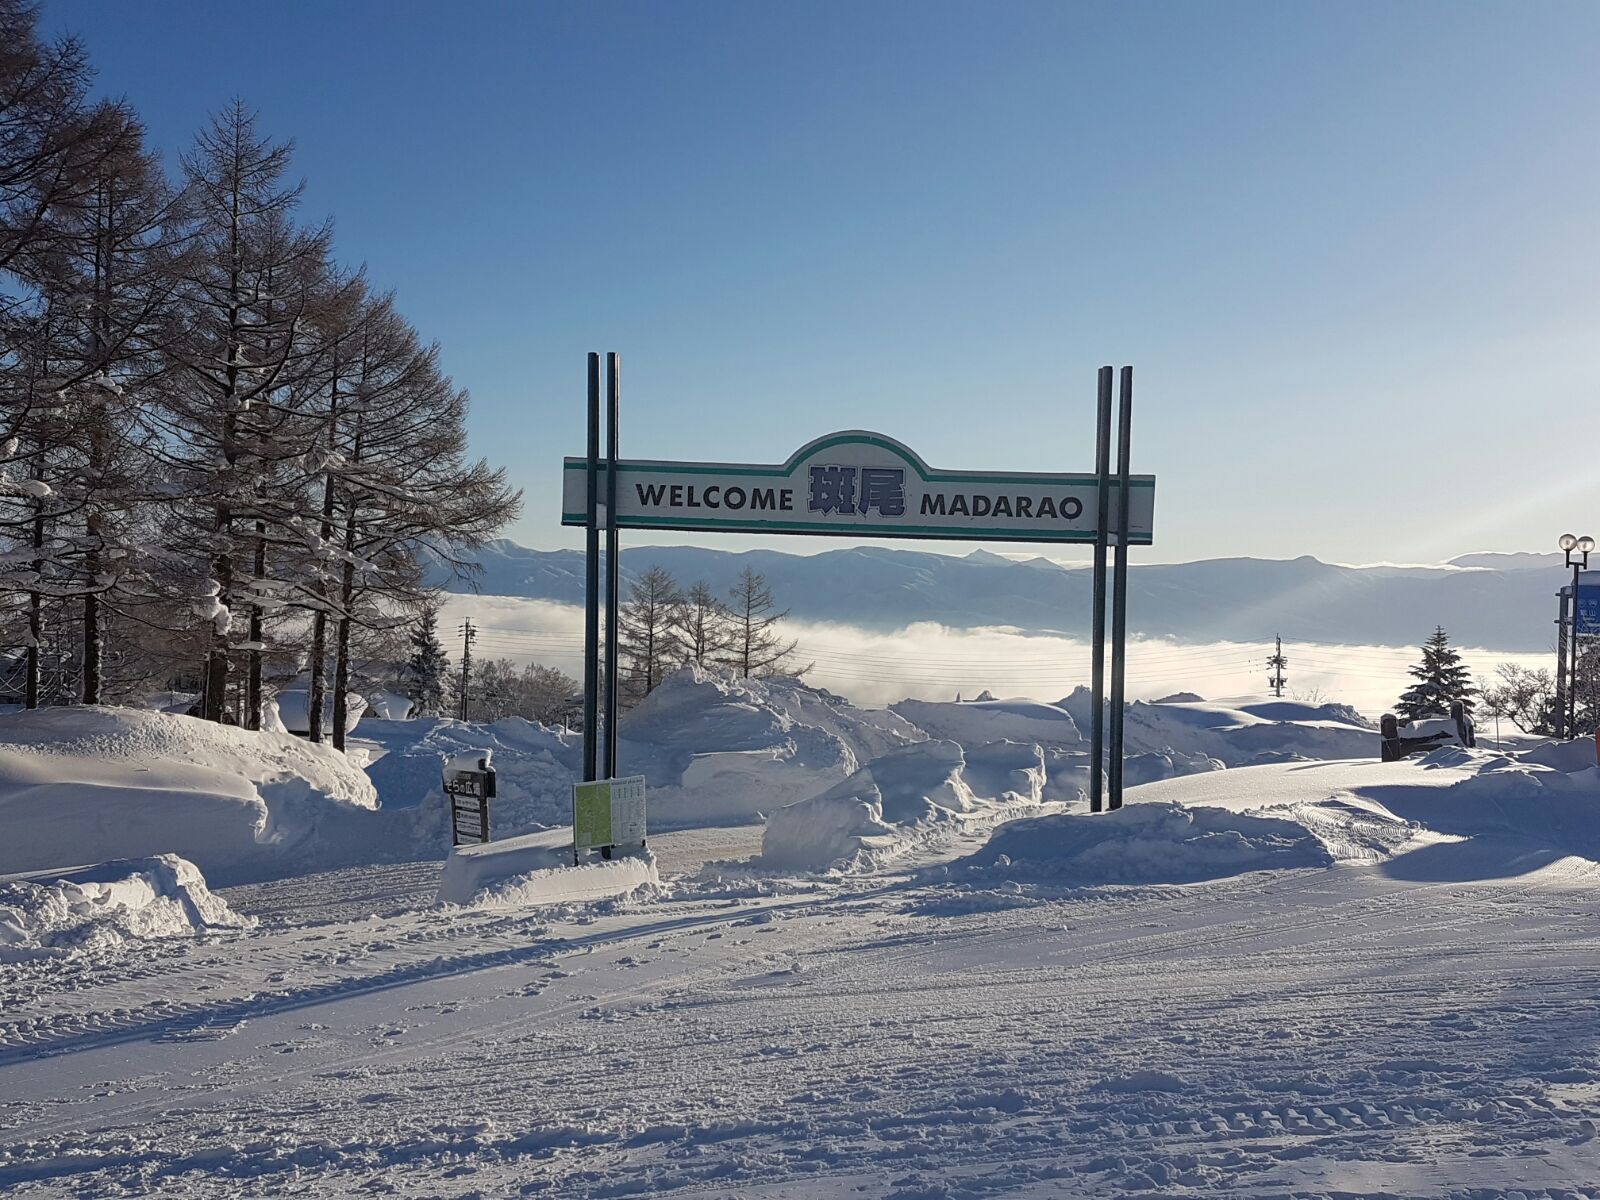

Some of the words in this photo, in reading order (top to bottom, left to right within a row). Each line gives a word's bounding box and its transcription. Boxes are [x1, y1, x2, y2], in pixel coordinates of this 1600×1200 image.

[635, 483, 793, 511] WELCOME
[808, 465, 906, 518] 斑尾
[920, 493, 1083, 519] MADARAO
